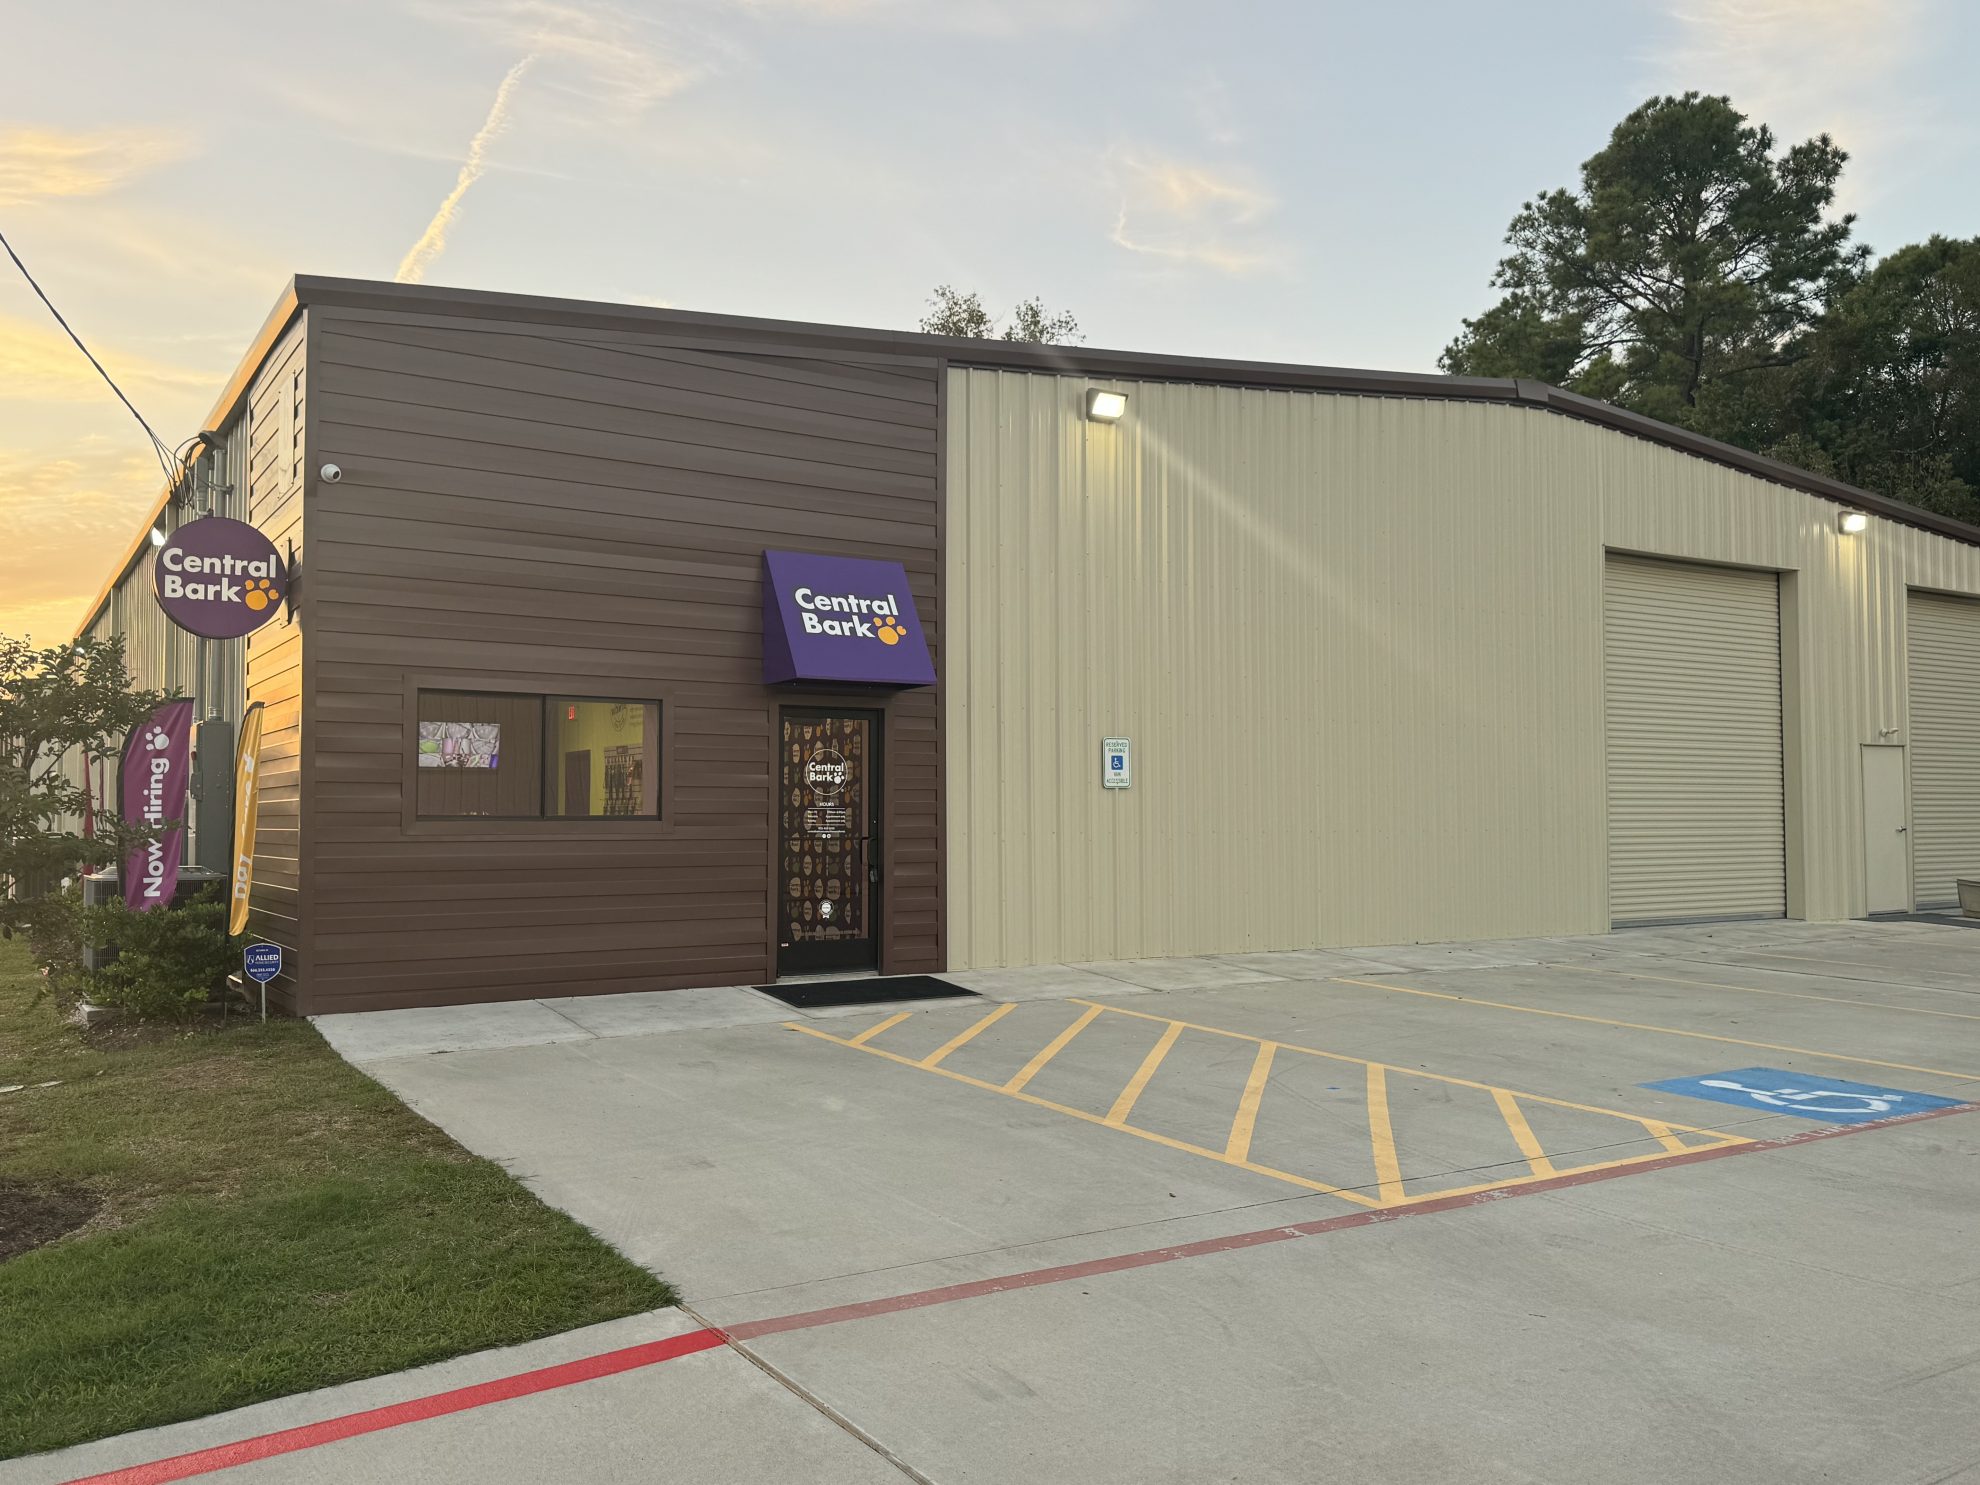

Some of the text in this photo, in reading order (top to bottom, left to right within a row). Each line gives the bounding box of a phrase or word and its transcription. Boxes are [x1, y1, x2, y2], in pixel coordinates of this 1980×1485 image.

[163, 547, 276, 578] Central
[164, 574, 242, 603] Bark
[795, 587, 899, 615] Central
[802, 612, 876, 637] Bark
[809, 762, 844, 772] Central
[810, 772, 834, 782] Bark
[143, 757, 170, 898] Now Hiring
